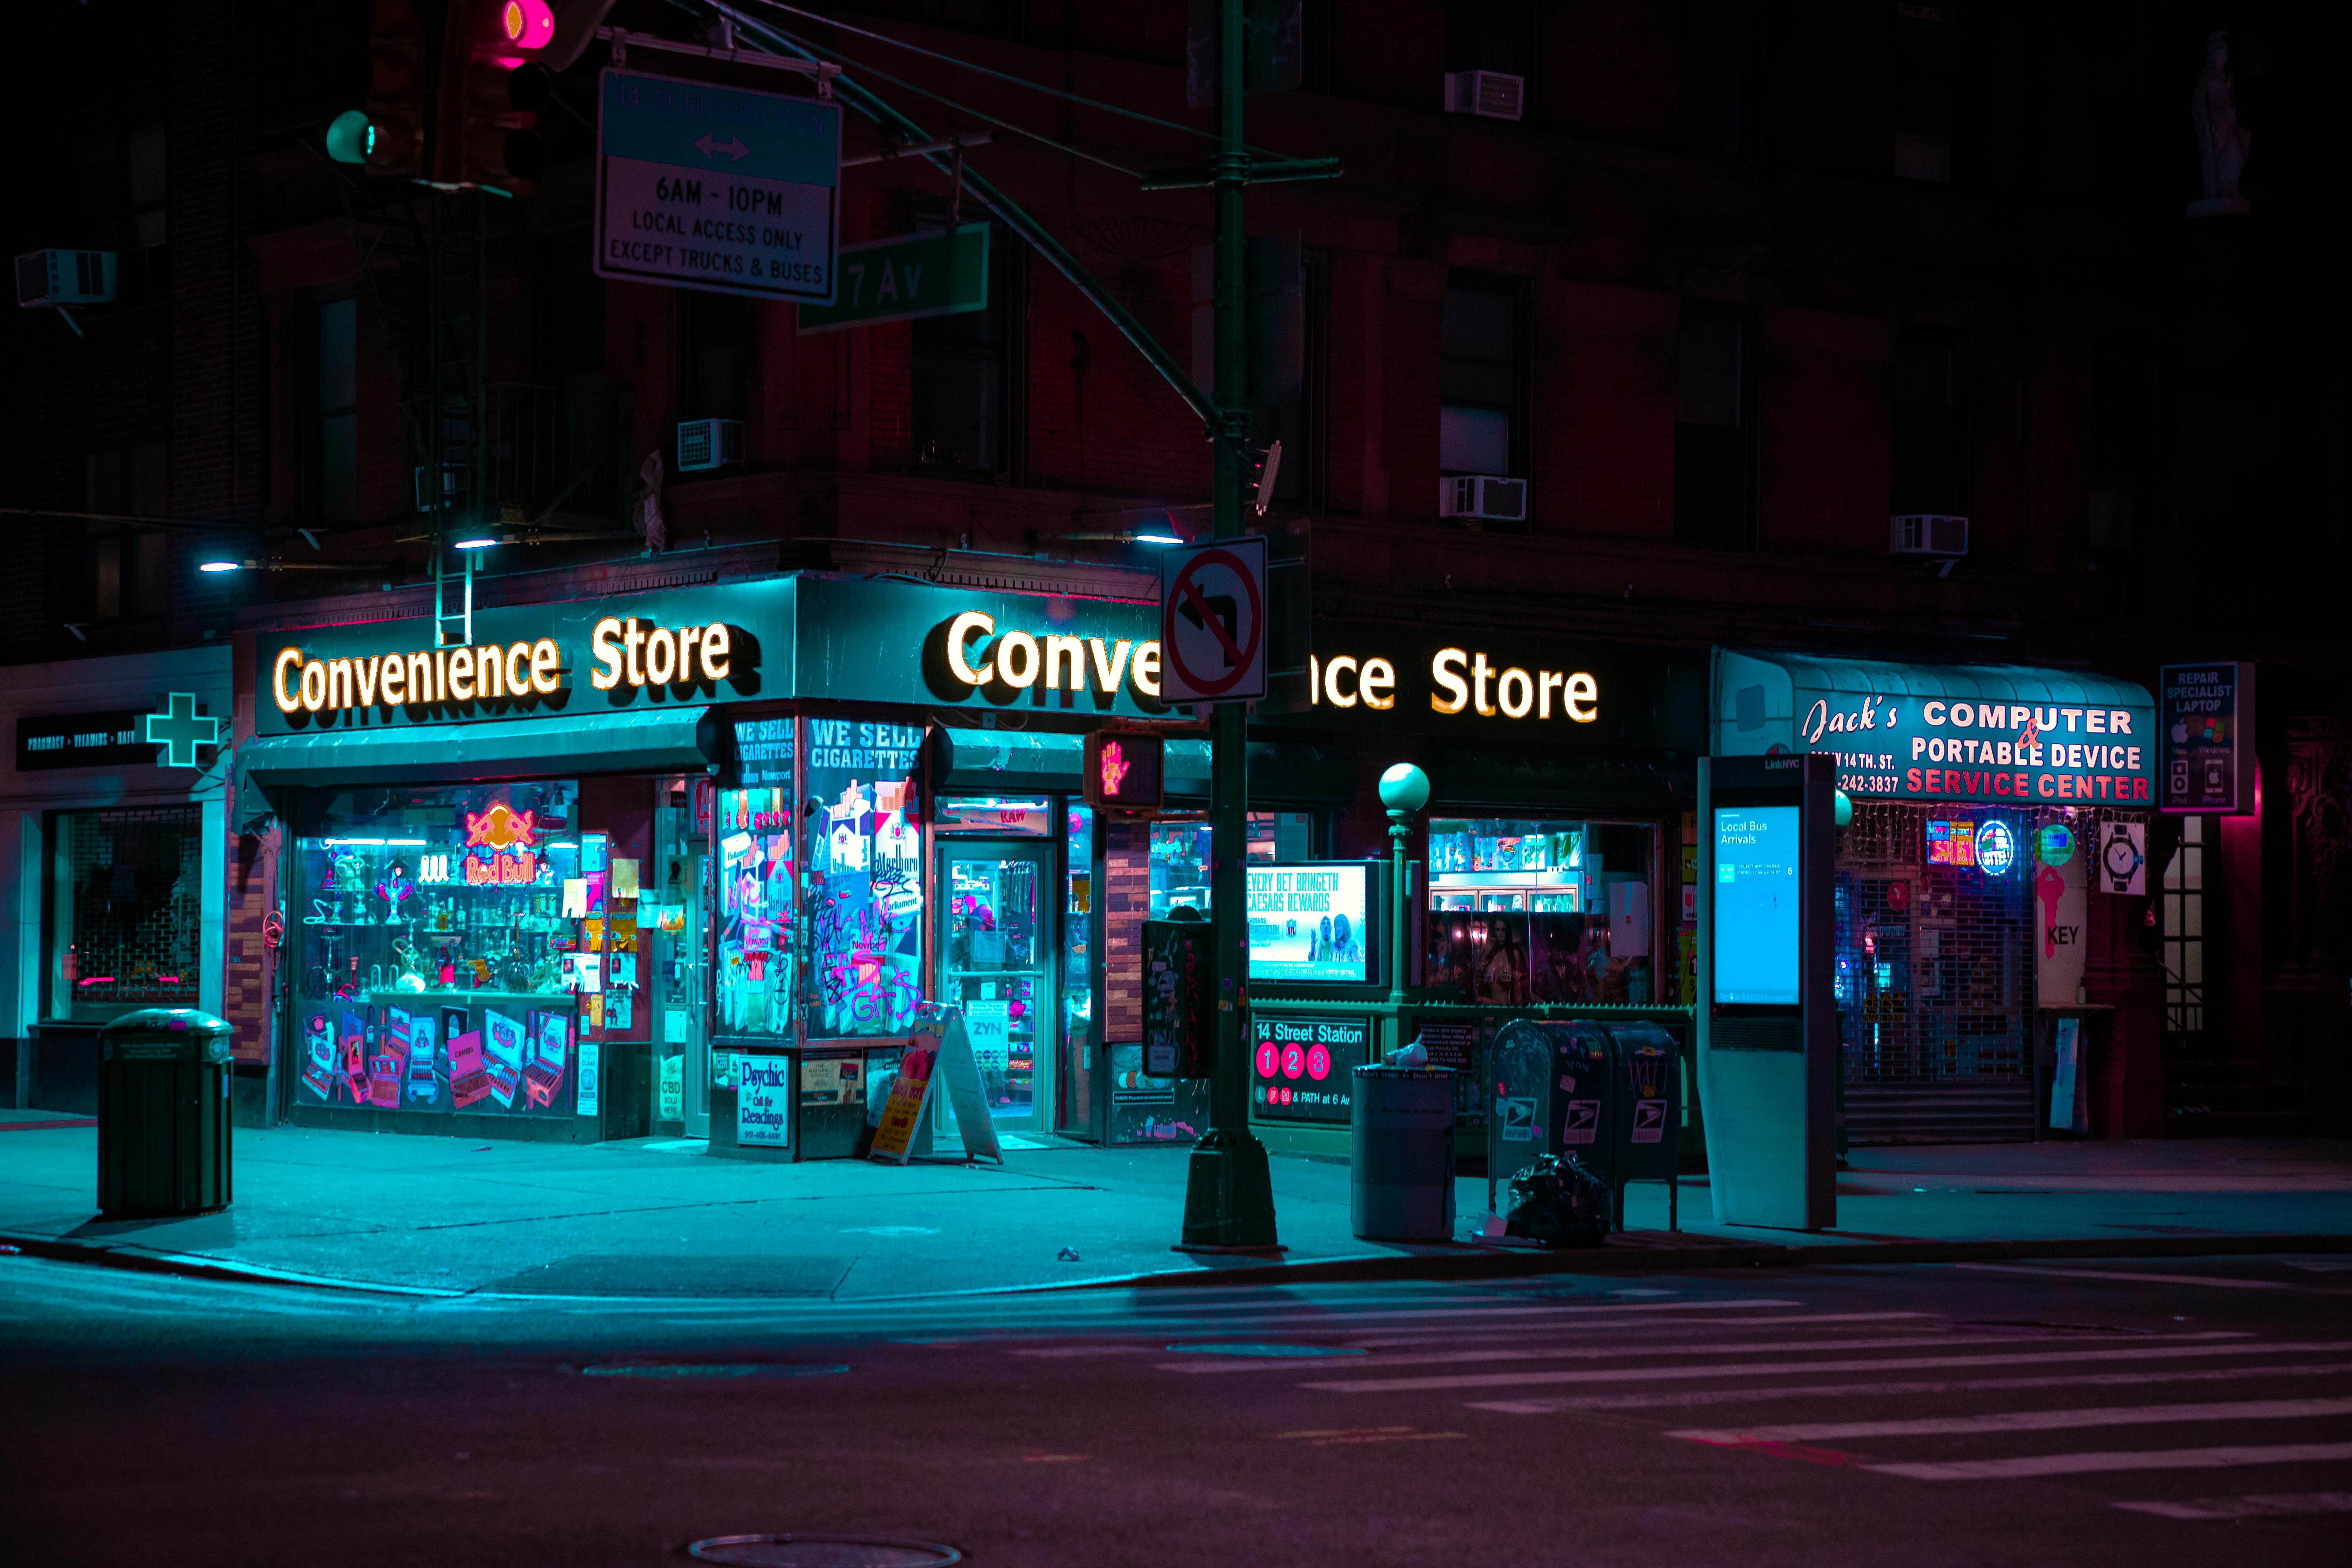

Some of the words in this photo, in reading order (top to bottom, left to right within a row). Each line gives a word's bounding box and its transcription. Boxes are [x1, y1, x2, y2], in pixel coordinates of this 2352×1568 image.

[621, 84, 640, 109] 14
[653, 92, 673, 116] St
[685, 97, 824, 136] RESTRICTION
[657, 177, 701, 205] 6AM
[729, 187, 782, 216] 10PM
[633, 211, 687, 233] LOCAL
[693, 218, 755, 245] ACCESS
[764, 227, 802, 251] ONLY
[611, 239, 674, 265] EXCEPT
[681, 249, 743, 273] TRUCKS
[751, 258, 762, 276] &
[771, 261, 822, 283] BUSES
[848, 265, 863, 307] 7
[878, 258, 922, 303] Av
[274, 637, 561, 713] Convenience
[591, 616, 730, 691] Store
[1431, 647, 1598, 723] Store
[2178, 671, 2219, 685] REPAIR
[2167, 685, 2232, 699] SPECIALIST
[2176, 699, 2221, 713] LAPTOP
[1802, 696, 1897, 744] Jack's
[1923, 701, 2132, 735] COMPUTER
[735, 722, 755, 742] WE
[759, 719, 794, 741] SELL
[812, 720, 850, 747] WE
[860, 722, 920, 748] SELL
[2017, 717, 2040, 750] &
[28, 735, 64, 751] PHARMACY
[74, 732, 107, 748] VITAMINS
[117, 730, 135, 745] NATU
[2199, 746, 2230, 754] Windows
[735, 742, 793, 761] CIGARETTES
[812, 748, 920, 769] CIGARETTES
[1911, 736, 2044, 767] PORTABLE
[2051, 744, 2141, 770] DEVICE
[1765, 759, 1800, 769] LinkNYC
[1844, 753, 1856, 768] 14
[1859, 753, 1877, 769] TH.
[1879, 754, 1895, 770] ST.
[762, 769, 791, 781] Newport
[1835, 774, 1898, 793] -242-3837
[1906, 768, 2030, 798] SERVICE
[2037, 771, 2149, 800] CENTER
[2172, 796, 2187, 804] iPod
[2202, 795, 2226, 804] iPhone
[1000, 808, 1029, 823] RAW
[1721, 821, 1746, 832] Local
[1749, 821, 1767, 831] Bus
[1721, 834, 1756, 844] Arrivals
[728, 849, 748, 861] Parliamen
[878, 844, 918, 872] Marlboro
[467, 853, 500, 884] Red
[502, 852, 534, 883] Bull
[1247, 873, 1273, 891] EVERY
[1277, 873, 1292, 891] BET
[1296, 873, 1338, 891] BRINGETH
[1247, 893, 1284, 911] CAESARS
[1288, 893, 1329, 911] REWARDS
[1250, 925, 1279, 935] PORTSBOOK
[2047, 926, 2079, 945] KEY
[973, 1022, 1001, 1035] ZYN
[1257, 1023, 1270, 1039] 14
[1275, 1023, 1312, 1041] Street
[1318, 1025, 1362, 1043] Station
[455, 1047, 474, 1058] COHIBA
[1264, 1050, 1270, 1069] 1
[1288, 1051, 1298, 1071] 2
[1314, 1053, 1323, 1072] 3
[742, 1061, 784, 1094] Psychic
[662, 1082, 680, 1094] CBD
[1258, 1090, 1263, 1099] L
[1270, 1091, 1276, 1101] F
[1282, 1091, 1289, 1102] M
[1293, 1093, 1298, 1102] &
[1301, 1093, 1319, 1103] PATH
[1323, 1094, 1330, 1104] at
[1333, 1094, 1338, 1104] 6
[753, 1097, 763, 1106] Call
[742, 1108, 783, 1131] Readings
